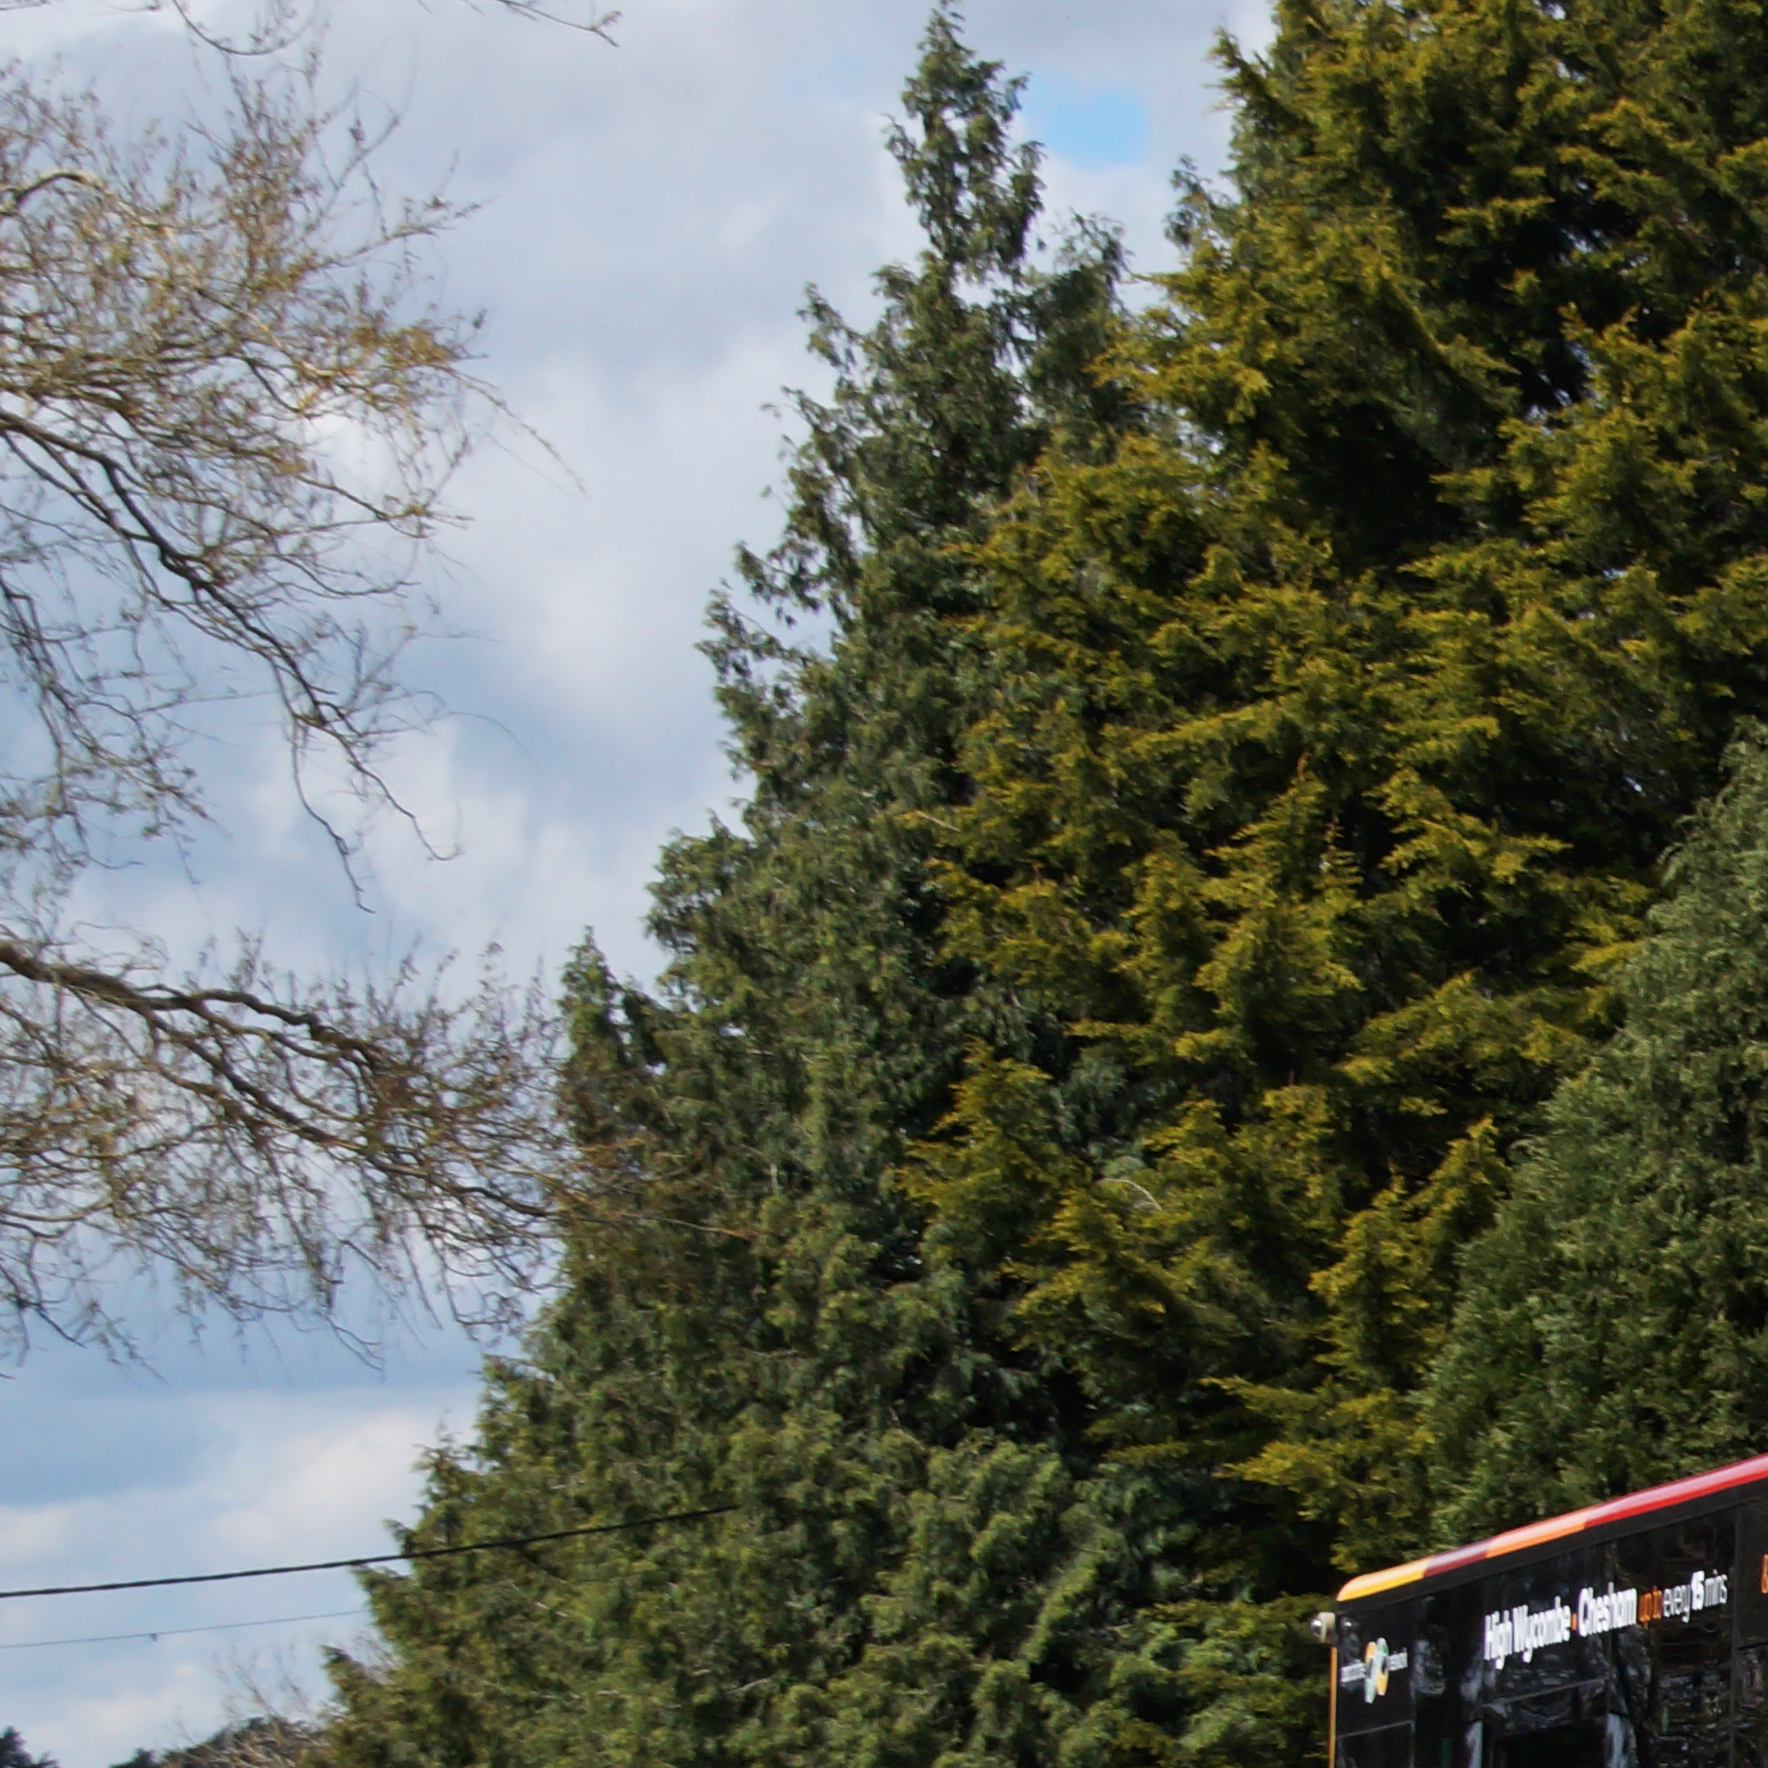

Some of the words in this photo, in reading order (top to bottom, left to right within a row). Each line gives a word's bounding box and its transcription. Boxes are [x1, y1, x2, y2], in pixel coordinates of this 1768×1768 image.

[1484, 1610, 1512, 1670] High
[1512, 1596, 1571, 1663] Wycombe
[1577, 1581, 1638, 1637] Chesham
[1663, 1584, 1691, 1623] every
[1690, 1570, 1705, 1611] 15
[1704, 1568, 1728, 1607] mins
